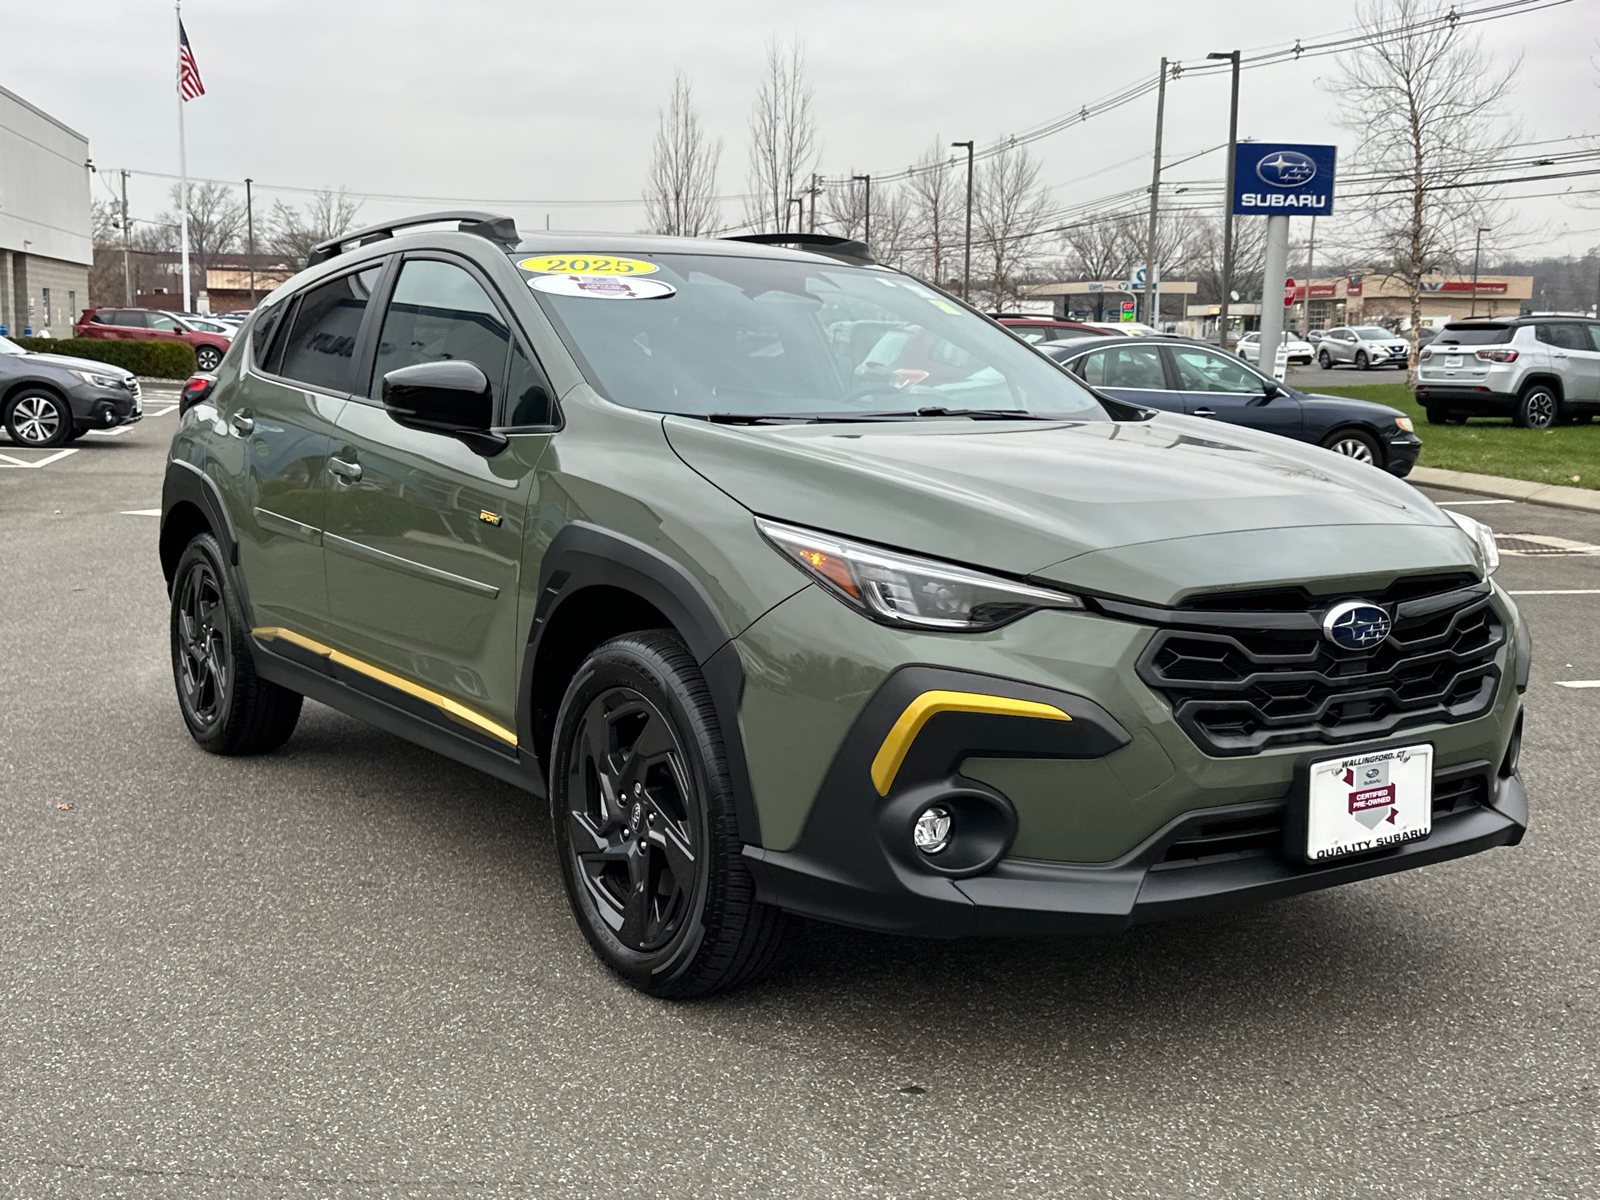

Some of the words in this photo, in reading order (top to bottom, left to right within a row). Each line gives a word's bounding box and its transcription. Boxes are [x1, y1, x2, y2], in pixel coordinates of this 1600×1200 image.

[1241, 193, 1326, 208] SUBARU
[546, 259, 635, 272] 2025
[1396, 750, 1407, 759] CT
[1363, 778, 1382, 786] SUBARU
[1356, 789, 1389, 801] CERTIFIED
[1352, 796, 1392, 809] PRE-OWNED
[1316, 839, 1372, 860] QUALITY
[1376, 827, 1428, 847] SUBARU
